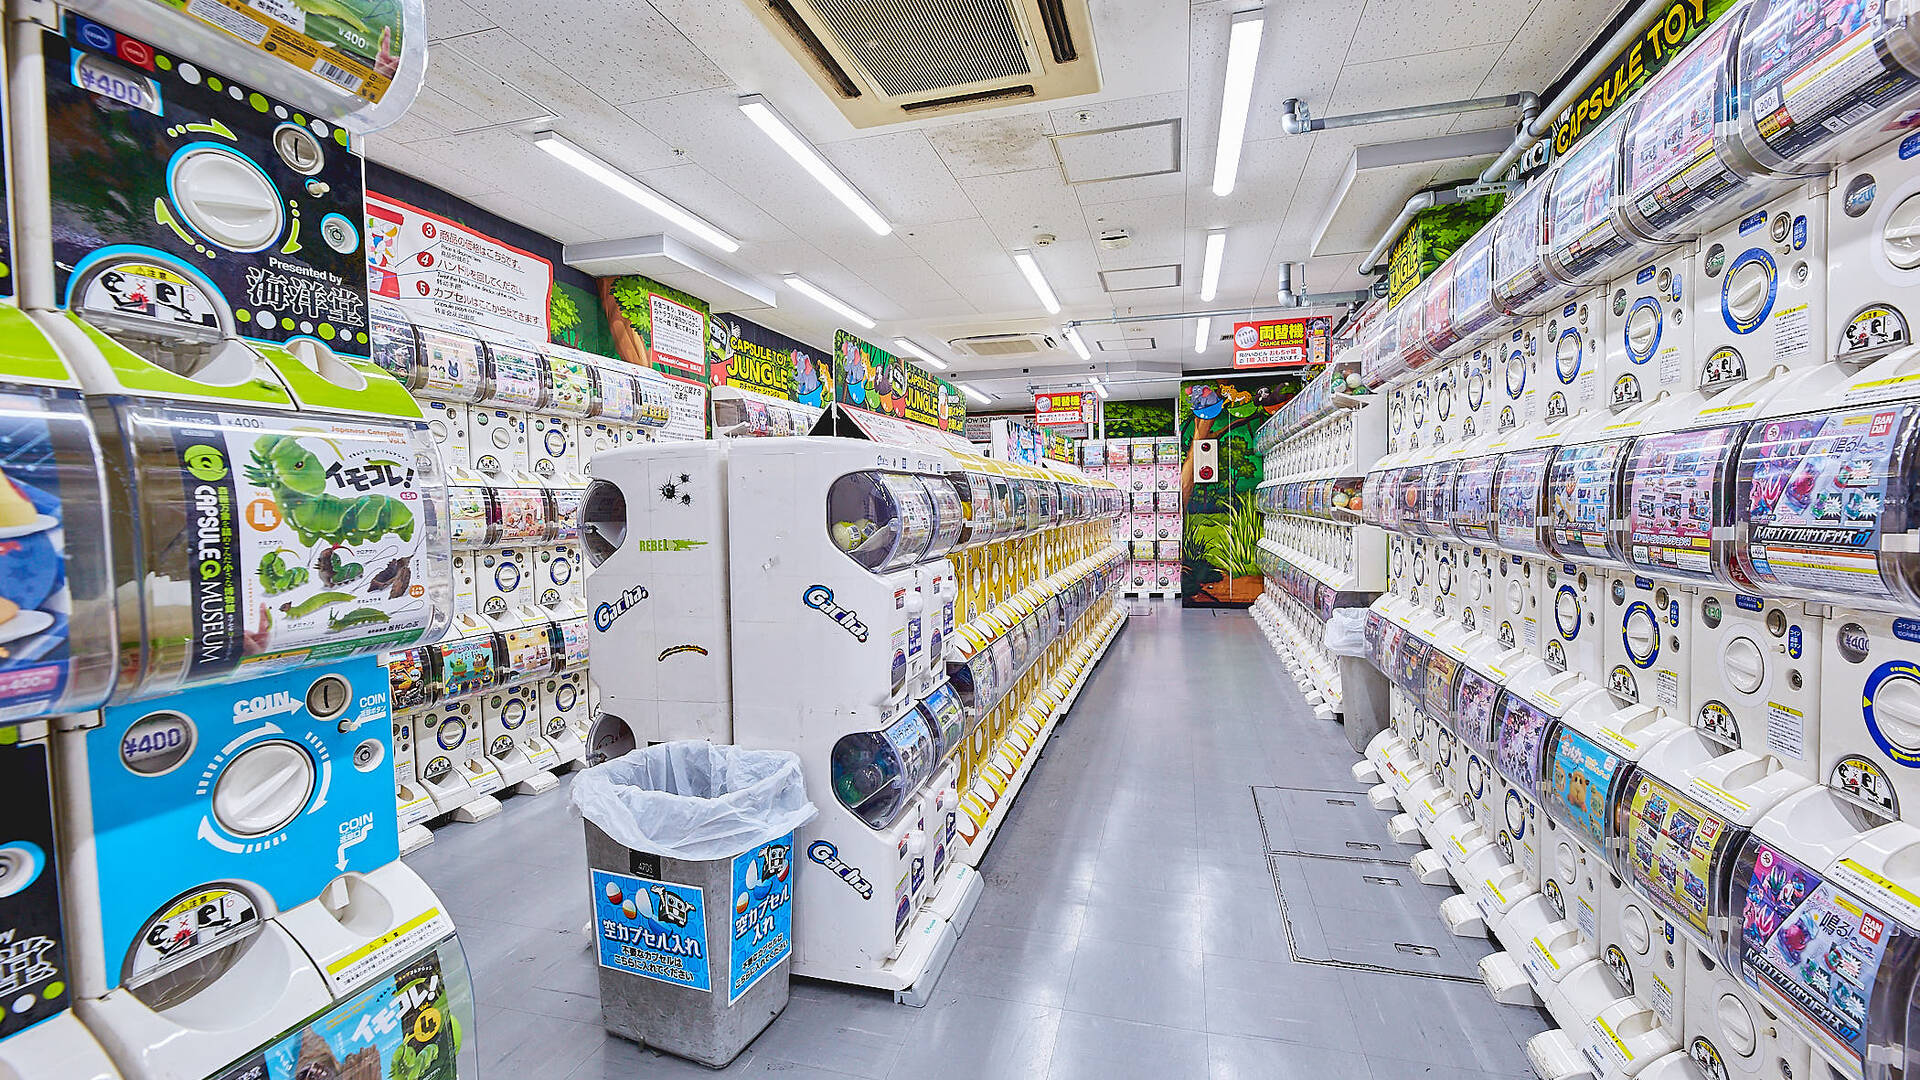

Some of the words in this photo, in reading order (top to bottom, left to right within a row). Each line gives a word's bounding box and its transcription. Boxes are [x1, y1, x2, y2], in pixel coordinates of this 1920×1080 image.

[81, 66, 142, 106] ¥400
[1556, 40, 1645, 154] CAPSULE
[1646, 0, 1707, 60] TOY
[268, 256, 327, 280] Presented
[328, 272, 343, 286] by
[1259, 322, 1304, 341] 両替機
[729, 336, 772, 361] CAPSULE
[726, 353, 789, 391] JUNGLE
[907, 372, 930, 390] CAPSULE
[905, 387, 938, 415] JUNGLE
[331, 425, 372, 437] Japanese
[1870, 424, 1888, 434] DAI
[1874, 415, 1894, 425] BAN
[325, 460, 415, 493] イモコレ!
[194, 485, 222, 561] CAPSULE
[253, 503, 276, 527] 4
[199, 581, 226, 665] MUSEUM
[233, 690, 290, 717] COIN
[359, 692, 386, 708] COIN
[124, 728, 182, 757] ¥400
[338, 812, 374, 834] COIN
[735, 884, 790, 940] 空カプセル
[1863, 916, 1884, 933] BAN
[602, 918, 704, 960] 空カプセル入れ
[751, 916, 775, 946] 入れ
[1860, 924, 1878, 940] DAI
[613, 954, 695, 981] こちらに入れてください
[621, 945, 683, 968] 不要なカプセルは
[351, 974, 439, 1043] イモコレ!
[420, 1014, 437, 1035] 4
